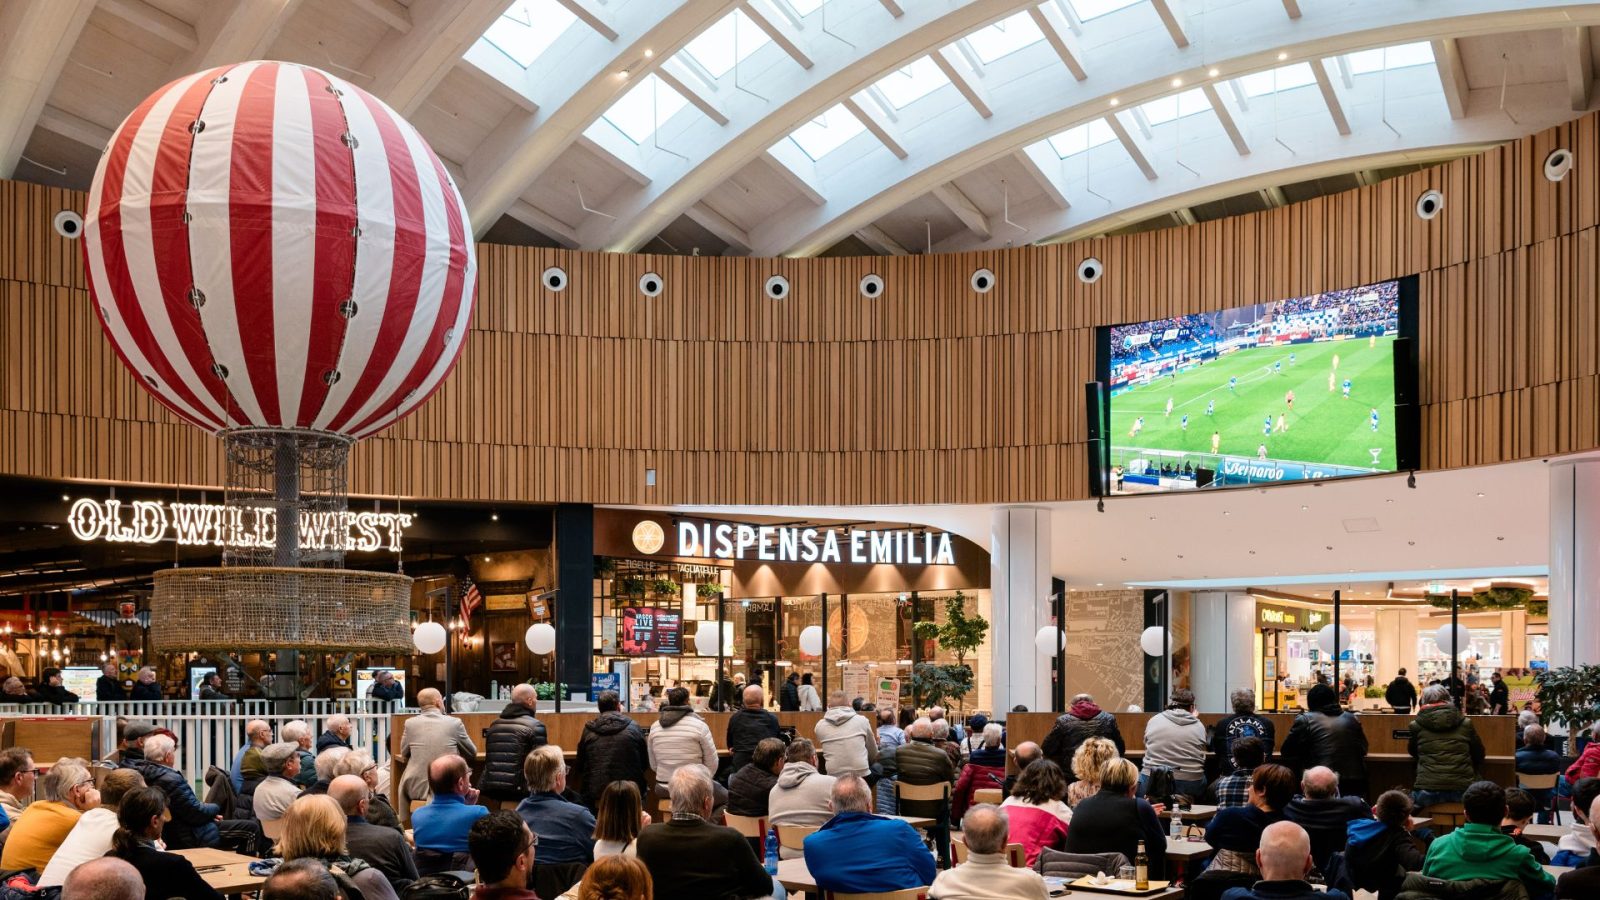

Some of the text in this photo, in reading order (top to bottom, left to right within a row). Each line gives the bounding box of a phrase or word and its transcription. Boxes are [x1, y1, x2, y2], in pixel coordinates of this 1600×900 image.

[68, 498, 168, 544] OLD
[678, 521, 955, 564] DISPENSA EMILIA
[1229, 718, 1264, 735] ATALANTA
